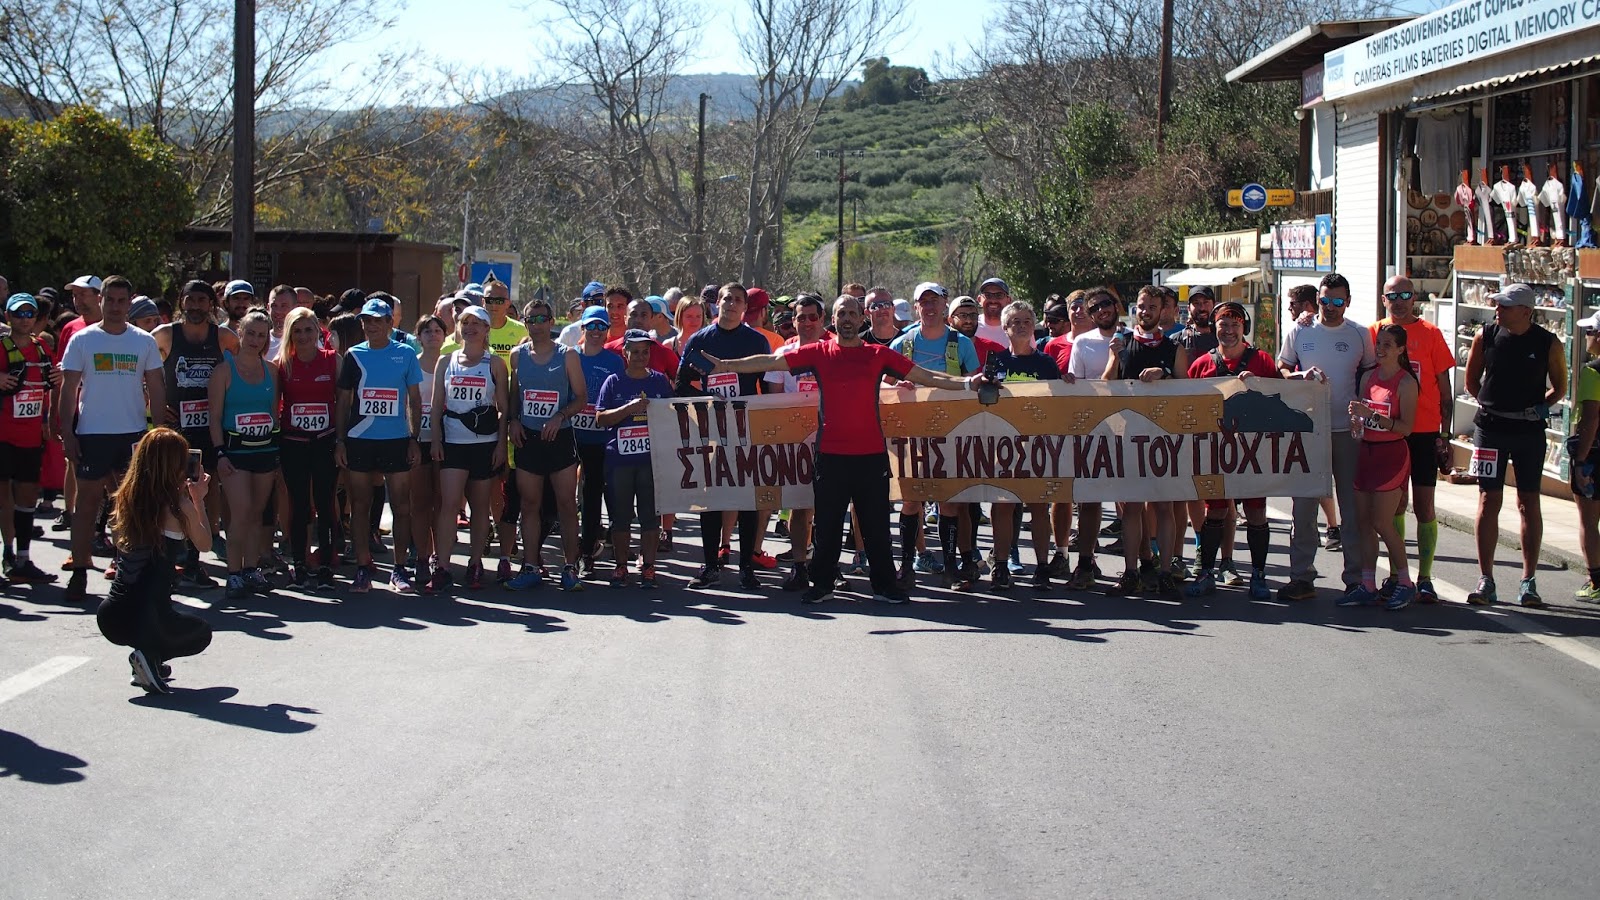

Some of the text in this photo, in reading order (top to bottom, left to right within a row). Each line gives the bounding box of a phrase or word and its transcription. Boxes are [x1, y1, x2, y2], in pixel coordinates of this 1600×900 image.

[1354, 62, 1391, 87] CAMERAS
[1394, 53, 1418, 76] FILMS
[1422, 39, 1463, 67] BATERIES
[1468, 24, 1511, 55] DIGITAL
[1515, 2, 1577, 41] MEMORY
[453, 387, 482, 400] 2816
[365, 401, 393, 415] 2881
[528, 403, 555, 417] 2867
[296, 416, 325, 429] 2849
[241, 425, 269, 436] 2870
[623, 438, 650, 453] 2848
[735, 442, 816, 487] ΜΟΝΟ
[892, 436, 947, 479] ΤΗΣ
[955, 435, 1065, 479] ΚΝΩΣΟΥ
[1073, 435, 1125, 478] ΚΑΙ
[1131, 434, 1184, 477] ΤΟΥ
